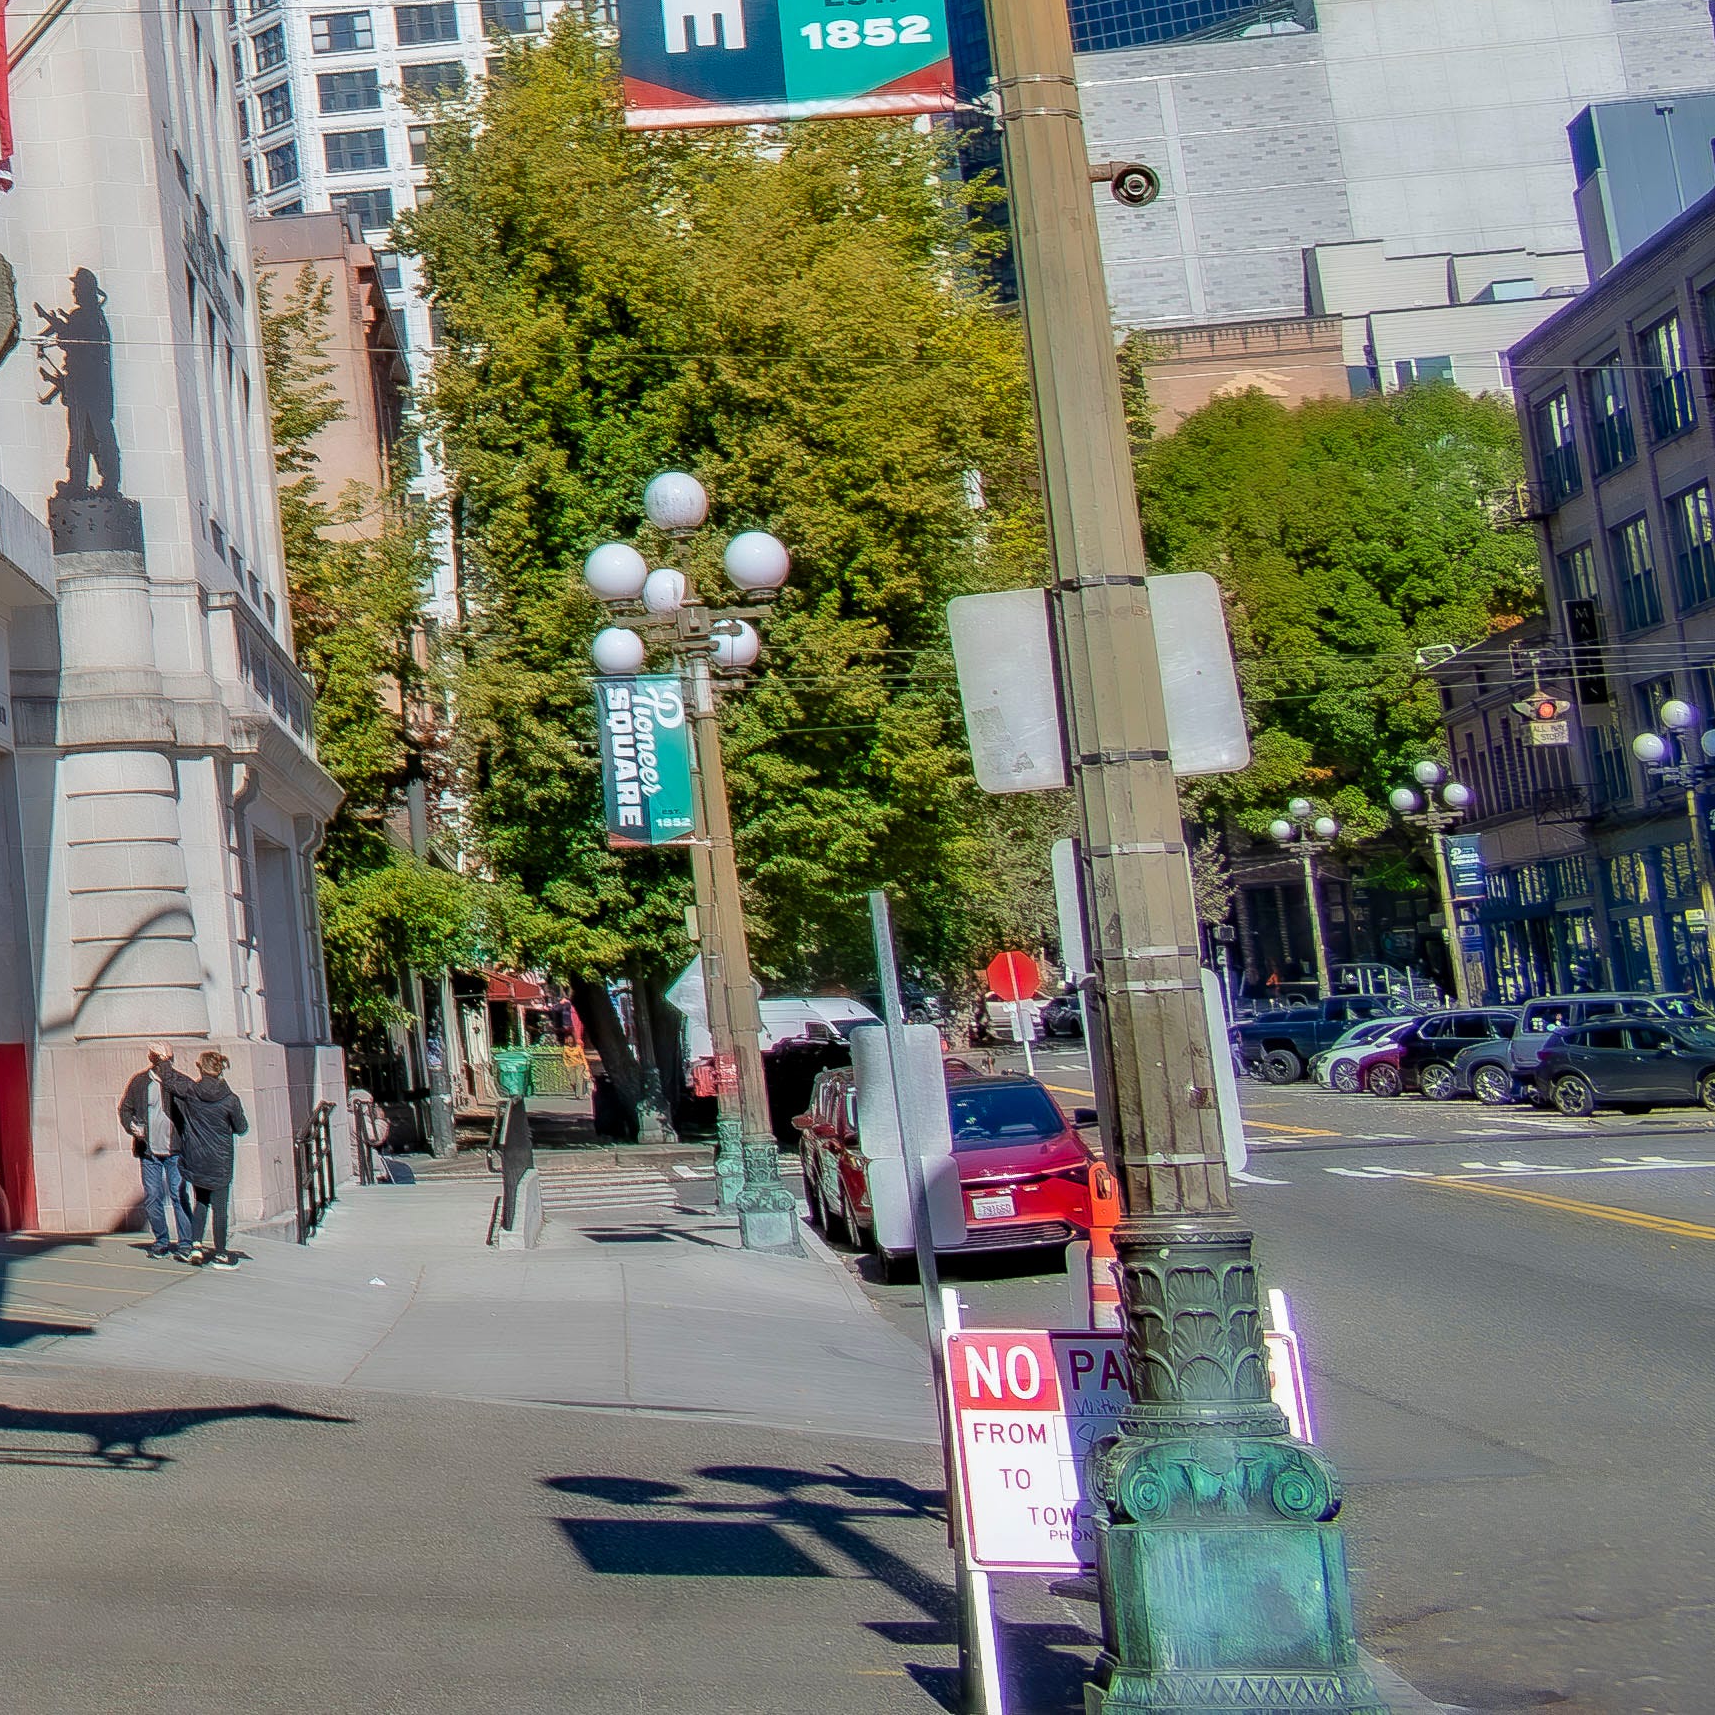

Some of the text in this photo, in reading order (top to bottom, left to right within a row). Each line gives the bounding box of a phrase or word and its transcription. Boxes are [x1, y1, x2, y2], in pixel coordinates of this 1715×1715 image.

[800, 14, 933, 50] 1852
[606, 687, 644, 827] SQUARE
[632, 686, 685, 797] Pioneer
[656, 817, 692, 828] 1852
[964, 1345, 1040, 1400] NO
[973, 1422, 1047, 1444] FROM
[999, 1468, 1031, 1490] TO
